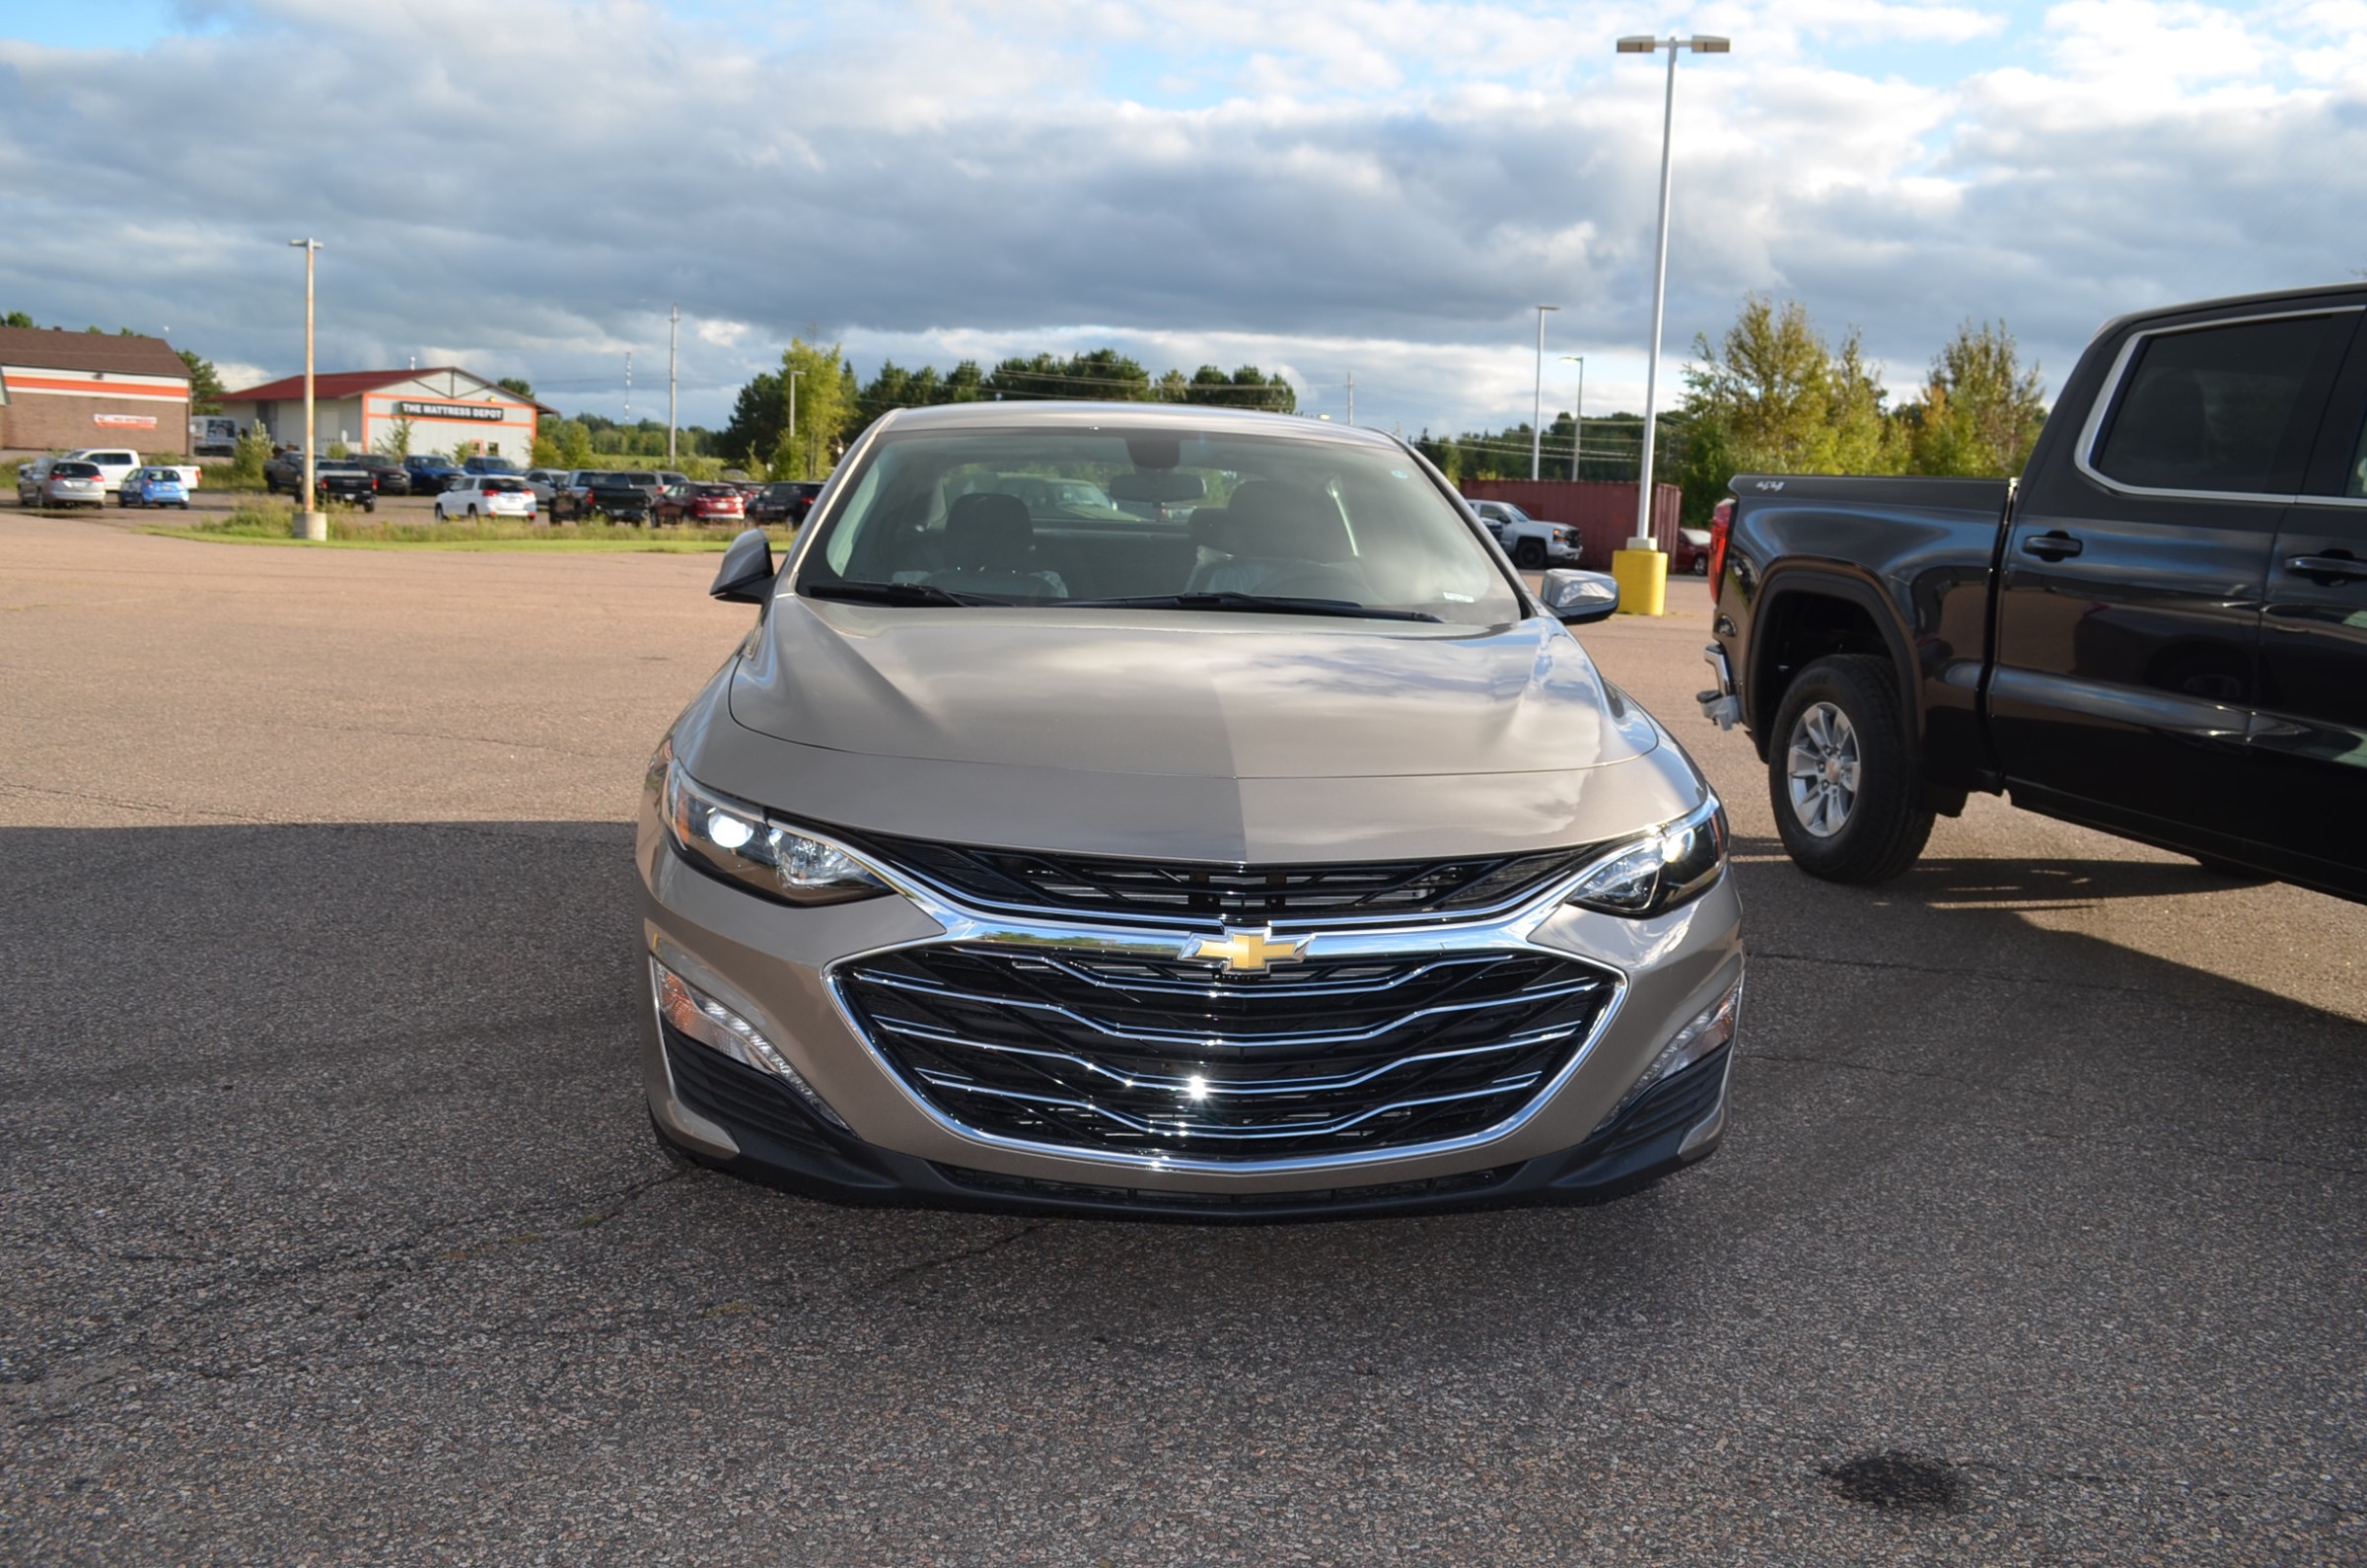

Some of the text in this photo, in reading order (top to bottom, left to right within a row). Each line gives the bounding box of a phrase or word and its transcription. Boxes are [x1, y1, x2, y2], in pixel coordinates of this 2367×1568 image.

[402, 402, 502, 419] THE MATTRESS DEPOT
